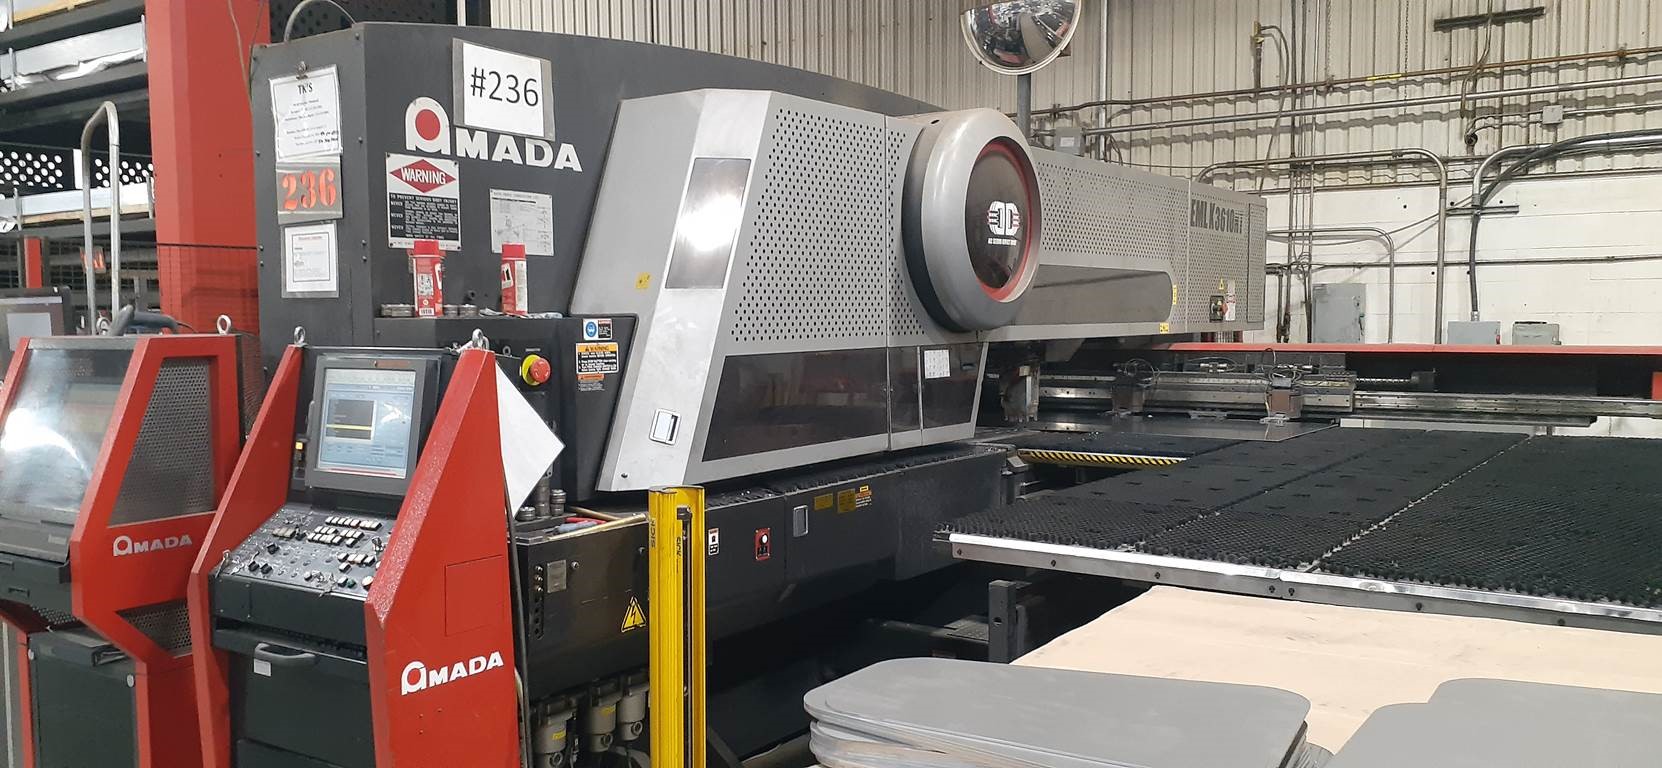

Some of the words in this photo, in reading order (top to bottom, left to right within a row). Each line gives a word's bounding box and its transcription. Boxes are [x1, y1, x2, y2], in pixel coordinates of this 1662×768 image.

[470, 67, 539, 107] #236
[405, 96, 583, 173] AMADA
[282, 168, 337, 211] 236
[400, 167, 446, 185] WARNING
[113, 534, 193, 557] AMADA
[401, 651, 504, 695] AMADA
